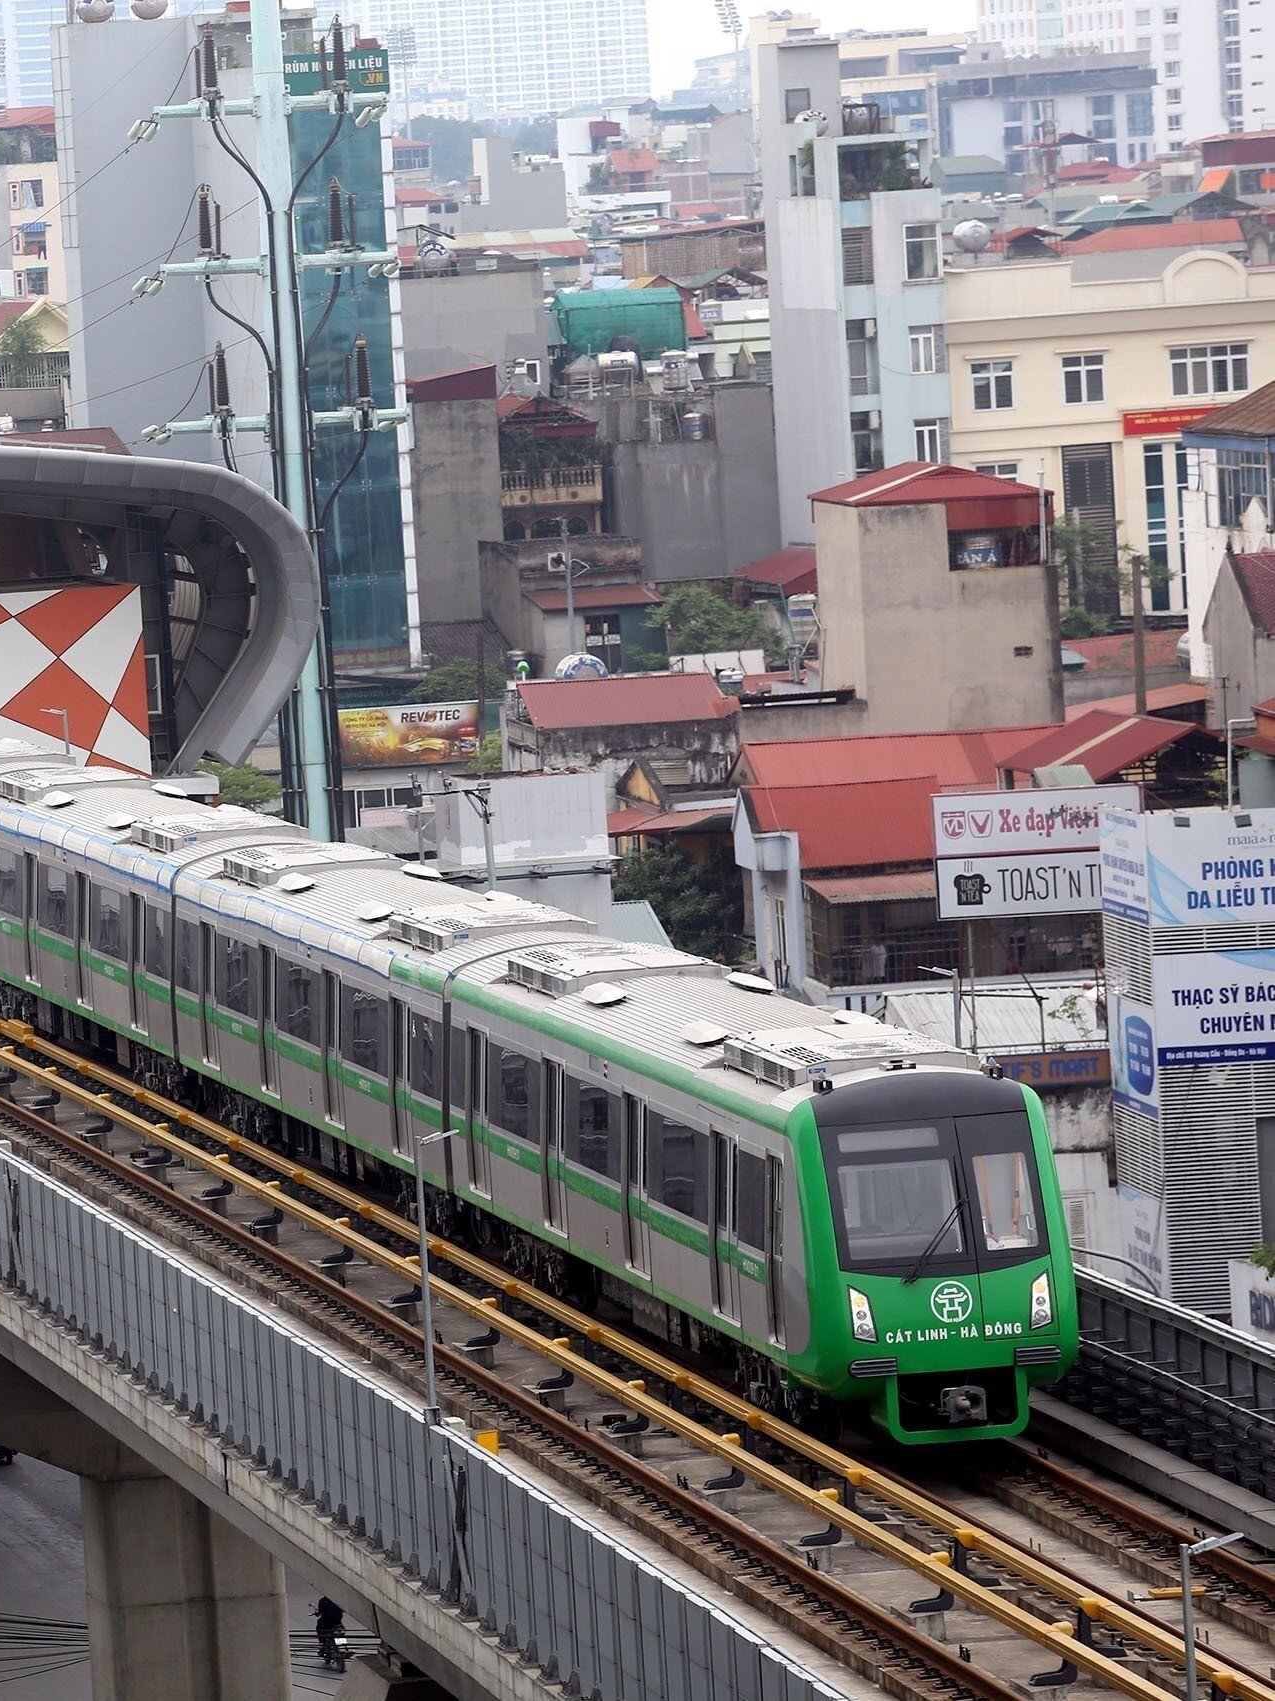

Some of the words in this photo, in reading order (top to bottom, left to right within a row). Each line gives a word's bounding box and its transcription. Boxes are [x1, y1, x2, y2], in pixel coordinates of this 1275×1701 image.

[284, 60, 309, 74] RÙM
[358, 55, 383, 71] LIỆU
[999, 809, 1021, 832] Xe
[1026, 807, 1055, 837] đạp
[1201, 856, 1265, 880] PHÒNG
[960, 878, 981, 891] TOAST
[967, 890, 981, 901] TEA
[1187, 890, 1212, 910] DA
[1216, 881, 1256, 908] LIỄU
[1172, 988, 1214, 1009] THẠC
[1219, 983, 1240, 1004] SỸ
[1200, 1011, 1265, 1034] CHUYÊN
[1048, 1057, 1100, 1078] MART
[886, 1329, 912, 1344] CÁT
[917, 1328, 948, 1341] LINH
[960, 1323, 979, 1338] HÀ
[984, 1320, 1023, 1336] ĐÔNG
